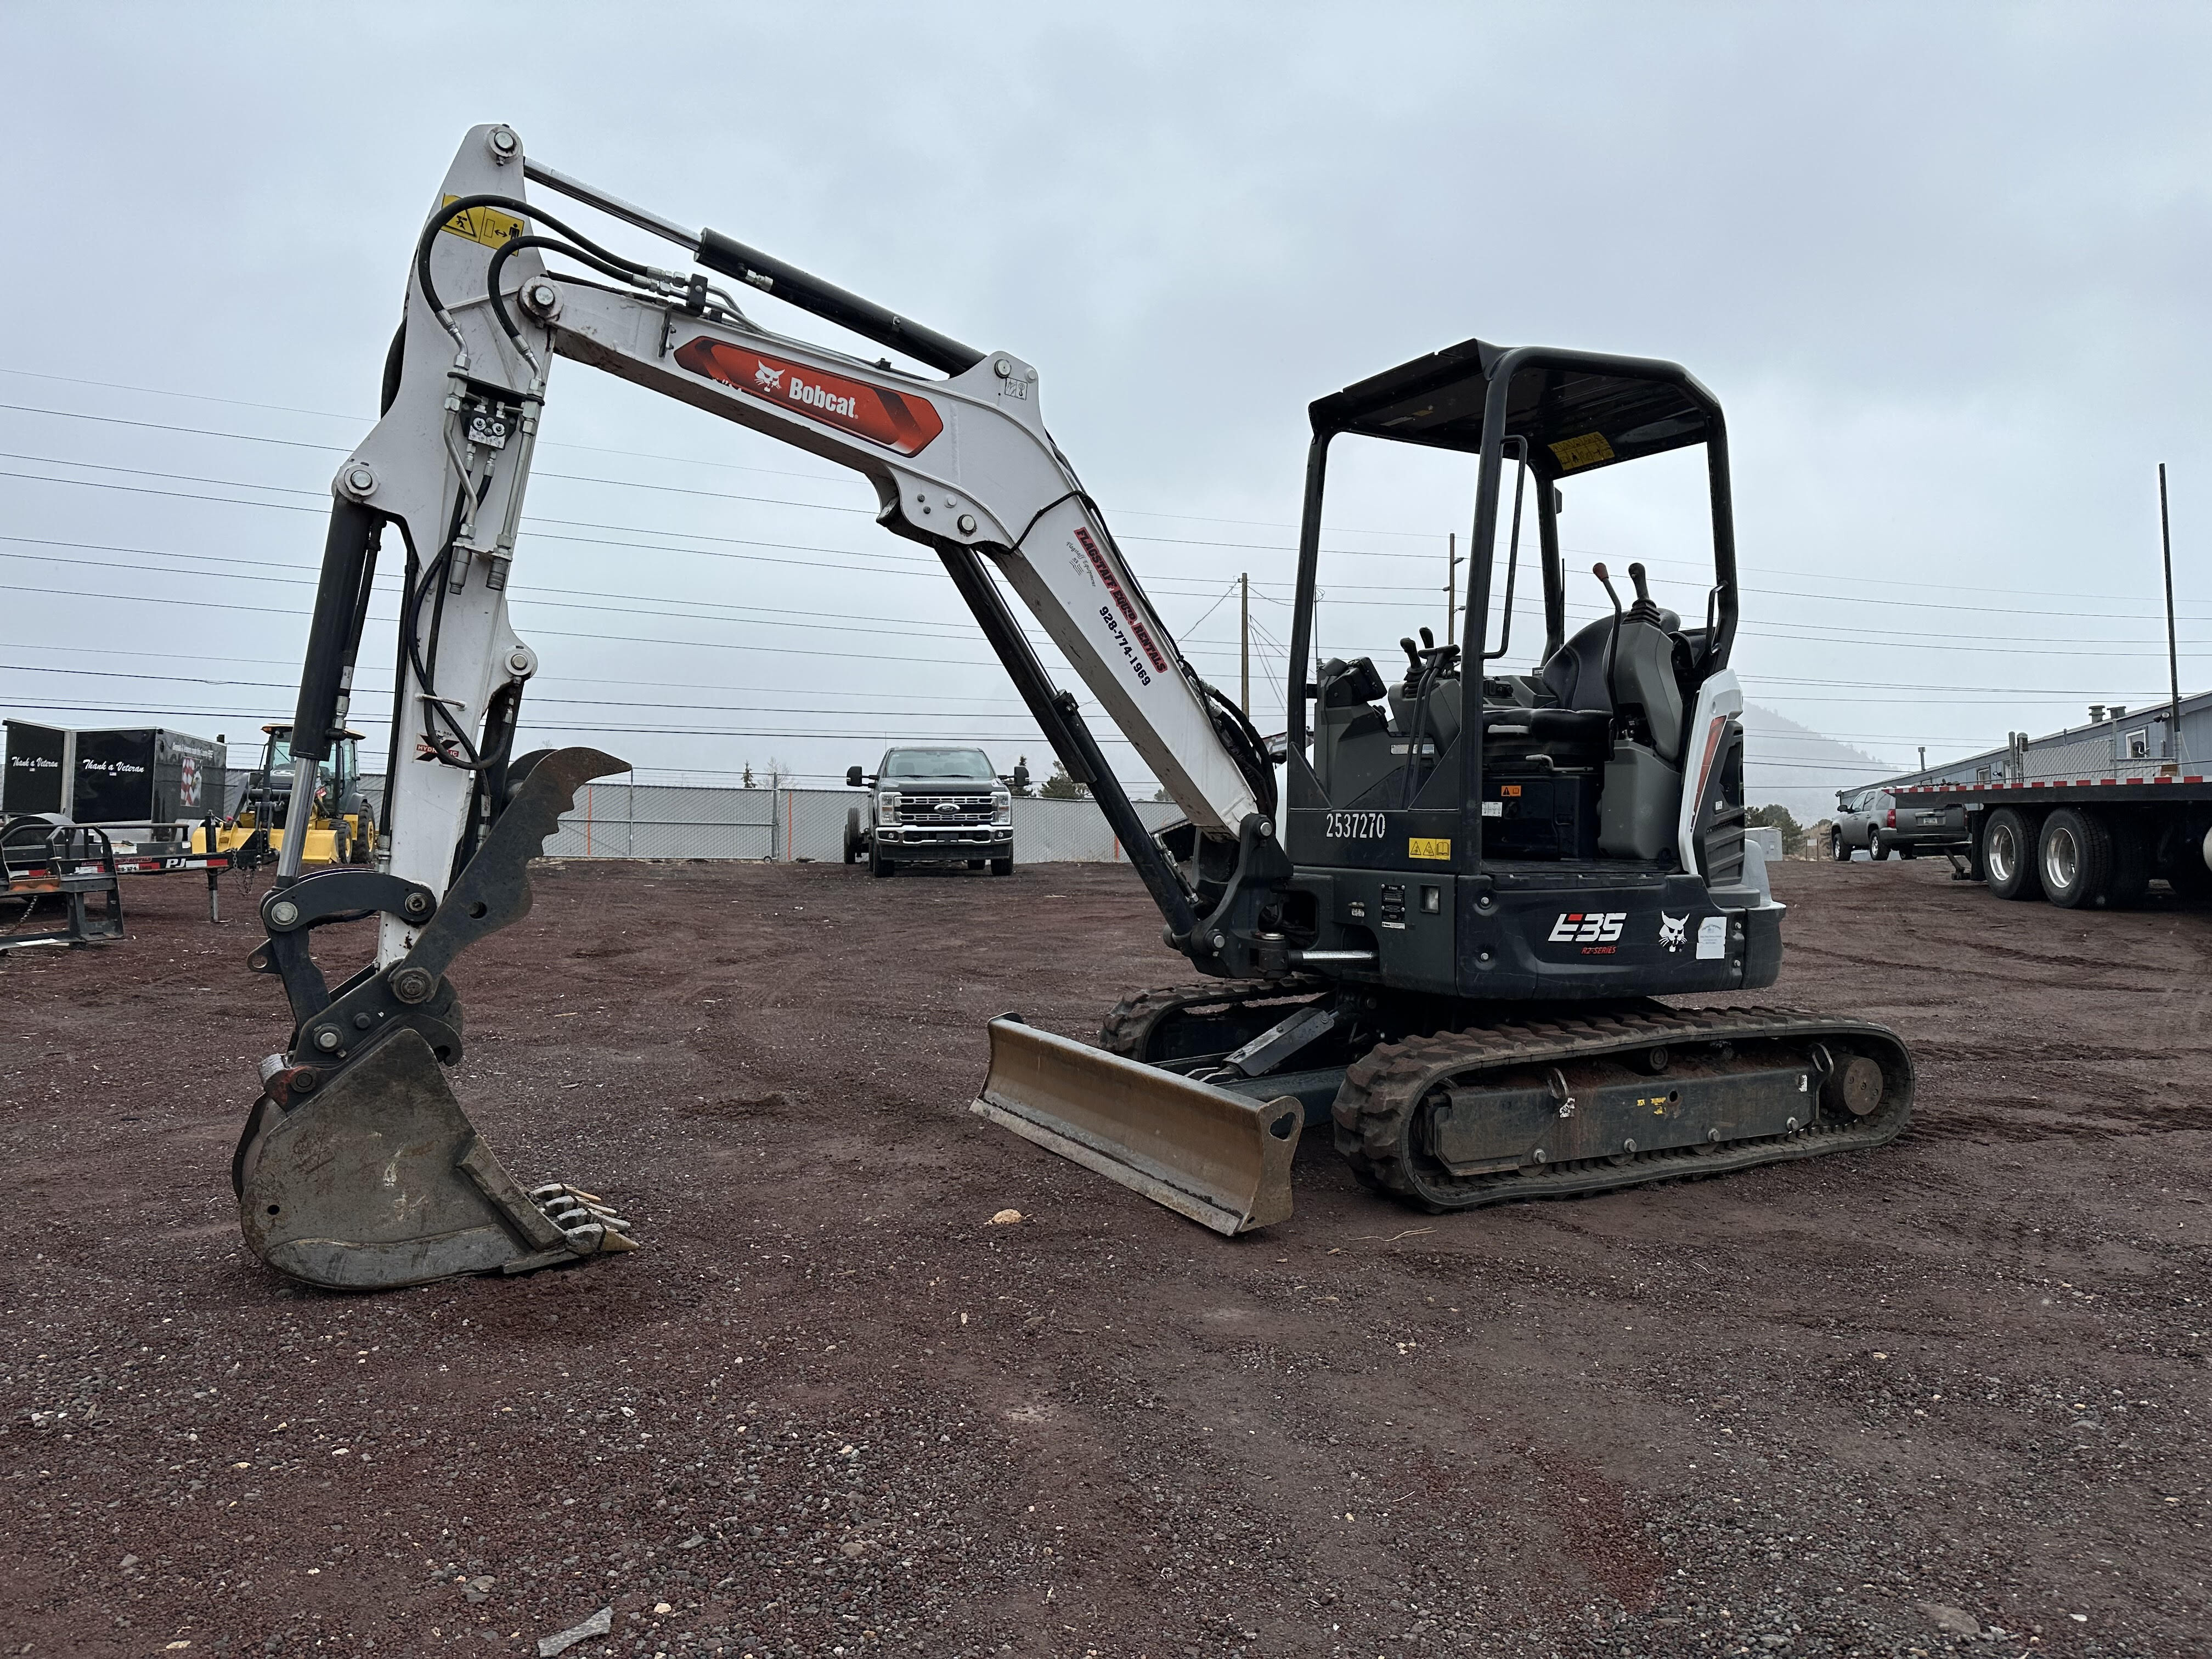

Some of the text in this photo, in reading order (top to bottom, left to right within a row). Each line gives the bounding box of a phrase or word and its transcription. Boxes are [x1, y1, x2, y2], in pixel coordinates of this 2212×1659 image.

[789, 377, 856, 419] Bobcat
[1066, 541, 1086, 560] Flagstaff
[1076, 528, 1118, 589] FLAGSTAFF
[1133, 624, 1166, 672] RENTALS
[1099, 606, 1151, 686] 928-774-1969
[12, 757, 30, 767] Thank
[36, 757, 58, 768] Veteran
[82, 759, 107, 771] Thank
[116, 761, 145, 773] Veteran
[1326, 813, 1385, 838] 2537270
[165, 858, 187, 868] PJ
[1548, 912, 1627, 942] E35
[1581, 946, 1617, 955] R2-SERIES
